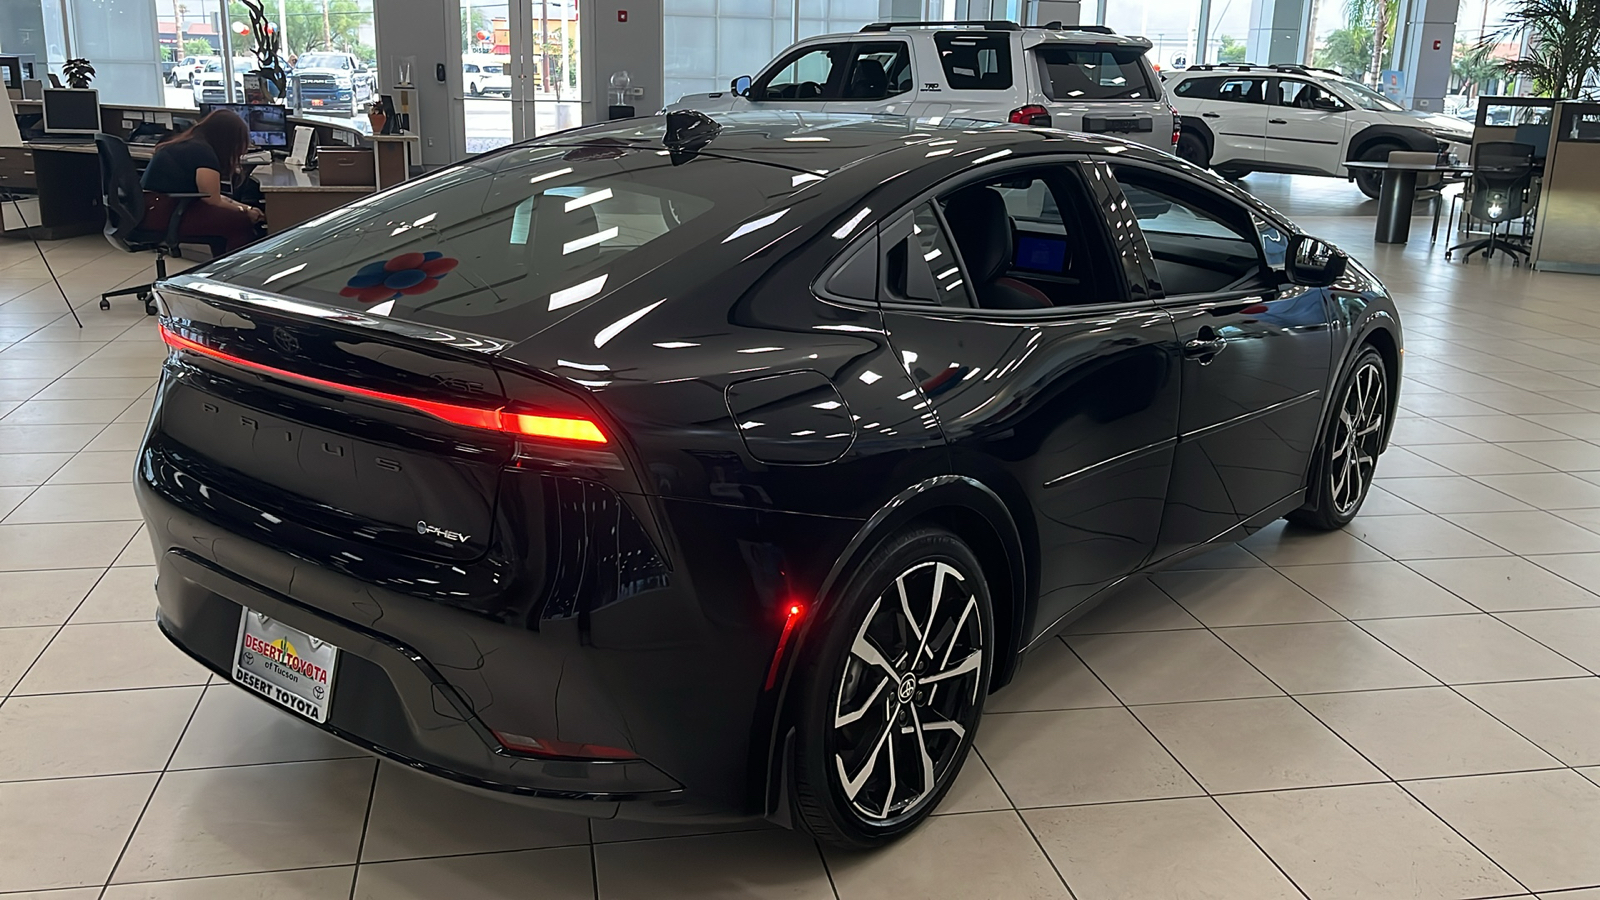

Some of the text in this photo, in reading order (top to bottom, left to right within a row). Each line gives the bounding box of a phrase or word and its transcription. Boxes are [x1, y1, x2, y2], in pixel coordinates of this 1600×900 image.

[434, 374, 484, 394] XSE
[203, 402, 402, 473] PRIUS
[426, 525, 471, 543] PHEV
[245, 634, 328, 685] DESERT TOYOTA
[264, 661, 299, 683] of Tucson
[236, 668, 319, 720] DESERT TOYOTA
